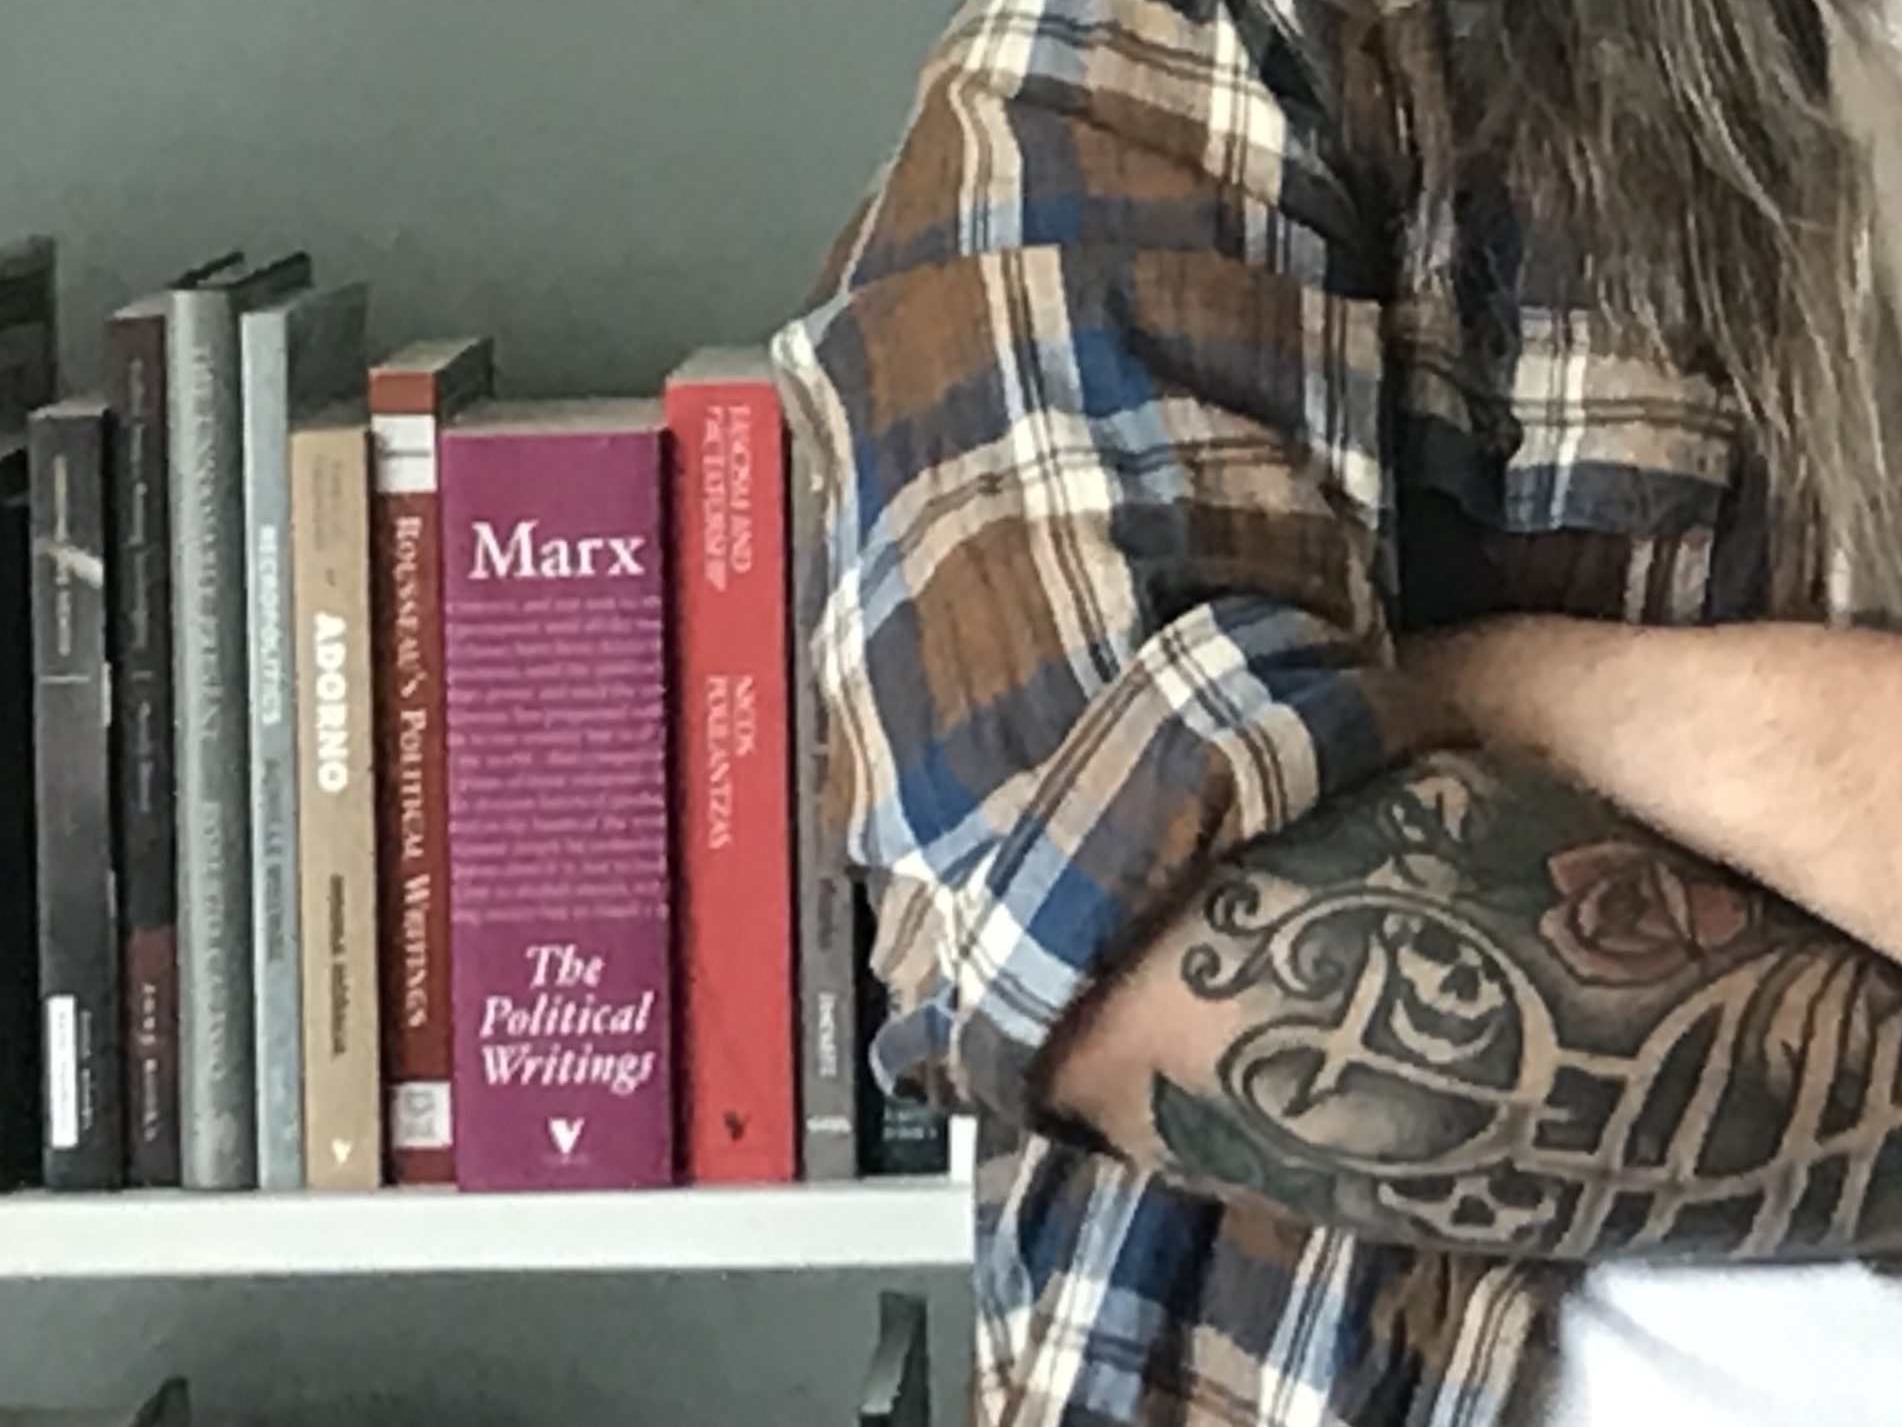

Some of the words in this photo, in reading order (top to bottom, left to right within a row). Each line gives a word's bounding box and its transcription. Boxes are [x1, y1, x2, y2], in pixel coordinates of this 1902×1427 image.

[468, 519, 646, 580] Marx
[313, 611, 349, 794] ADORNO
[399, 708, 428, 861] POLITICAL
[707, 674, 734, 850] POULANTZAS
[403, 873, 432, 1029] WRITINGS
[525, 943, 606, 990] The
[479, 990, 655, 1038] Political
[481, 1043, 656, 1095] Writings
